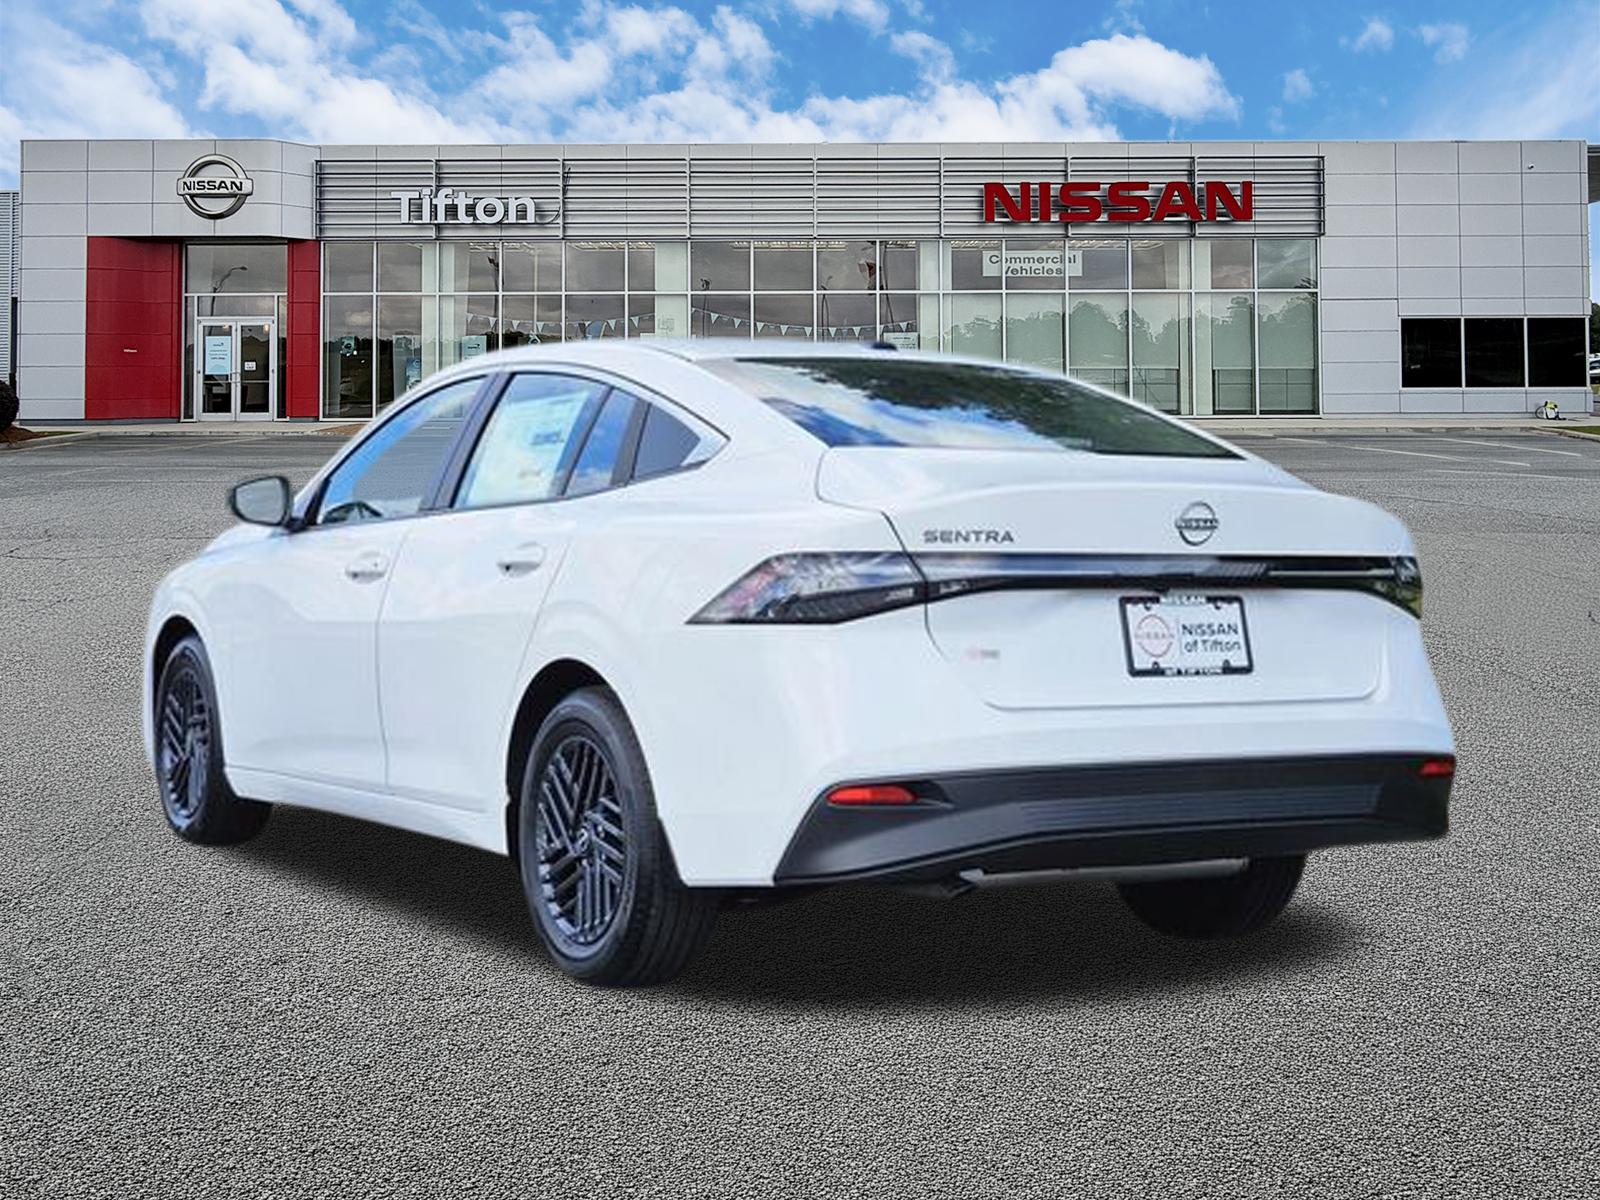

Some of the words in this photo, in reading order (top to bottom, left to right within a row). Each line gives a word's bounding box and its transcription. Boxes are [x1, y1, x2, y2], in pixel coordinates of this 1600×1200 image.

[182, 180, 243, 191] NISSAN
[391, 188, 536, 223] Tifton
[984, 181, 1253, 222] NISSAN
[923, 529, 1014, 543] SENTRA
[1181, 623, 1239, 636] NISSAN
[1184, 640, 1199, 652] of
[1202, 639, 1241, 652] Tifton
